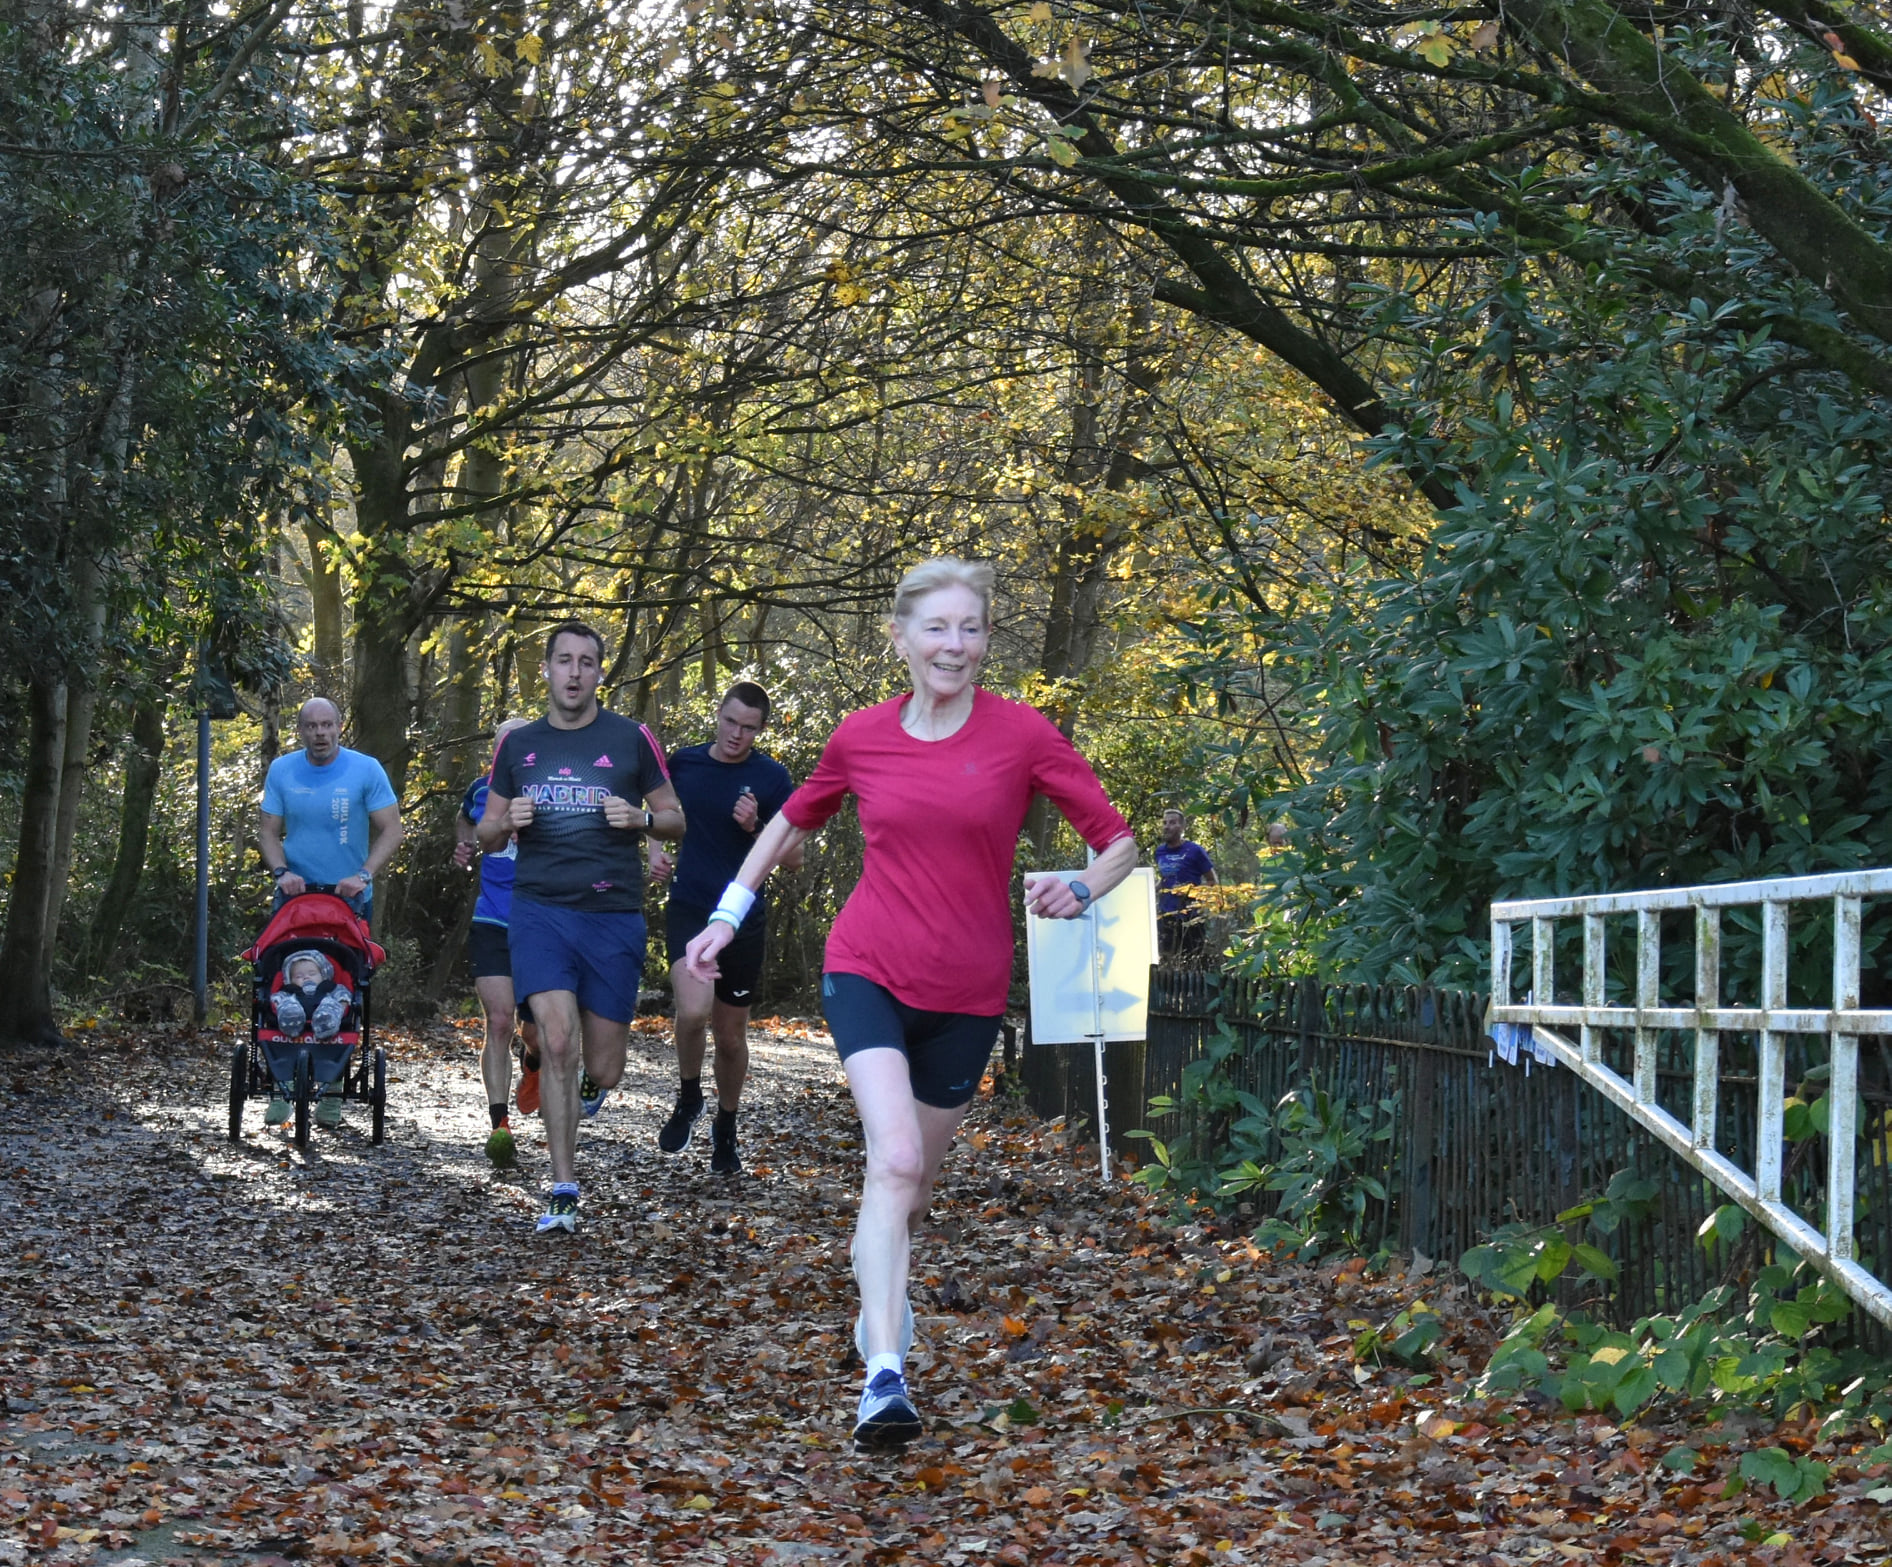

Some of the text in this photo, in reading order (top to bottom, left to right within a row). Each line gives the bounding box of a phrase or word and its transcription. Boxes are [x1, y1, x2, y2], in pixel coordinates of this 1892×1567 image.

[522, 785, 611, 806] MADRID
[331, 797, 340, 820] 2019
[340, 797, 349, 823] HULL
[339, 825, 348, 845] 10K
